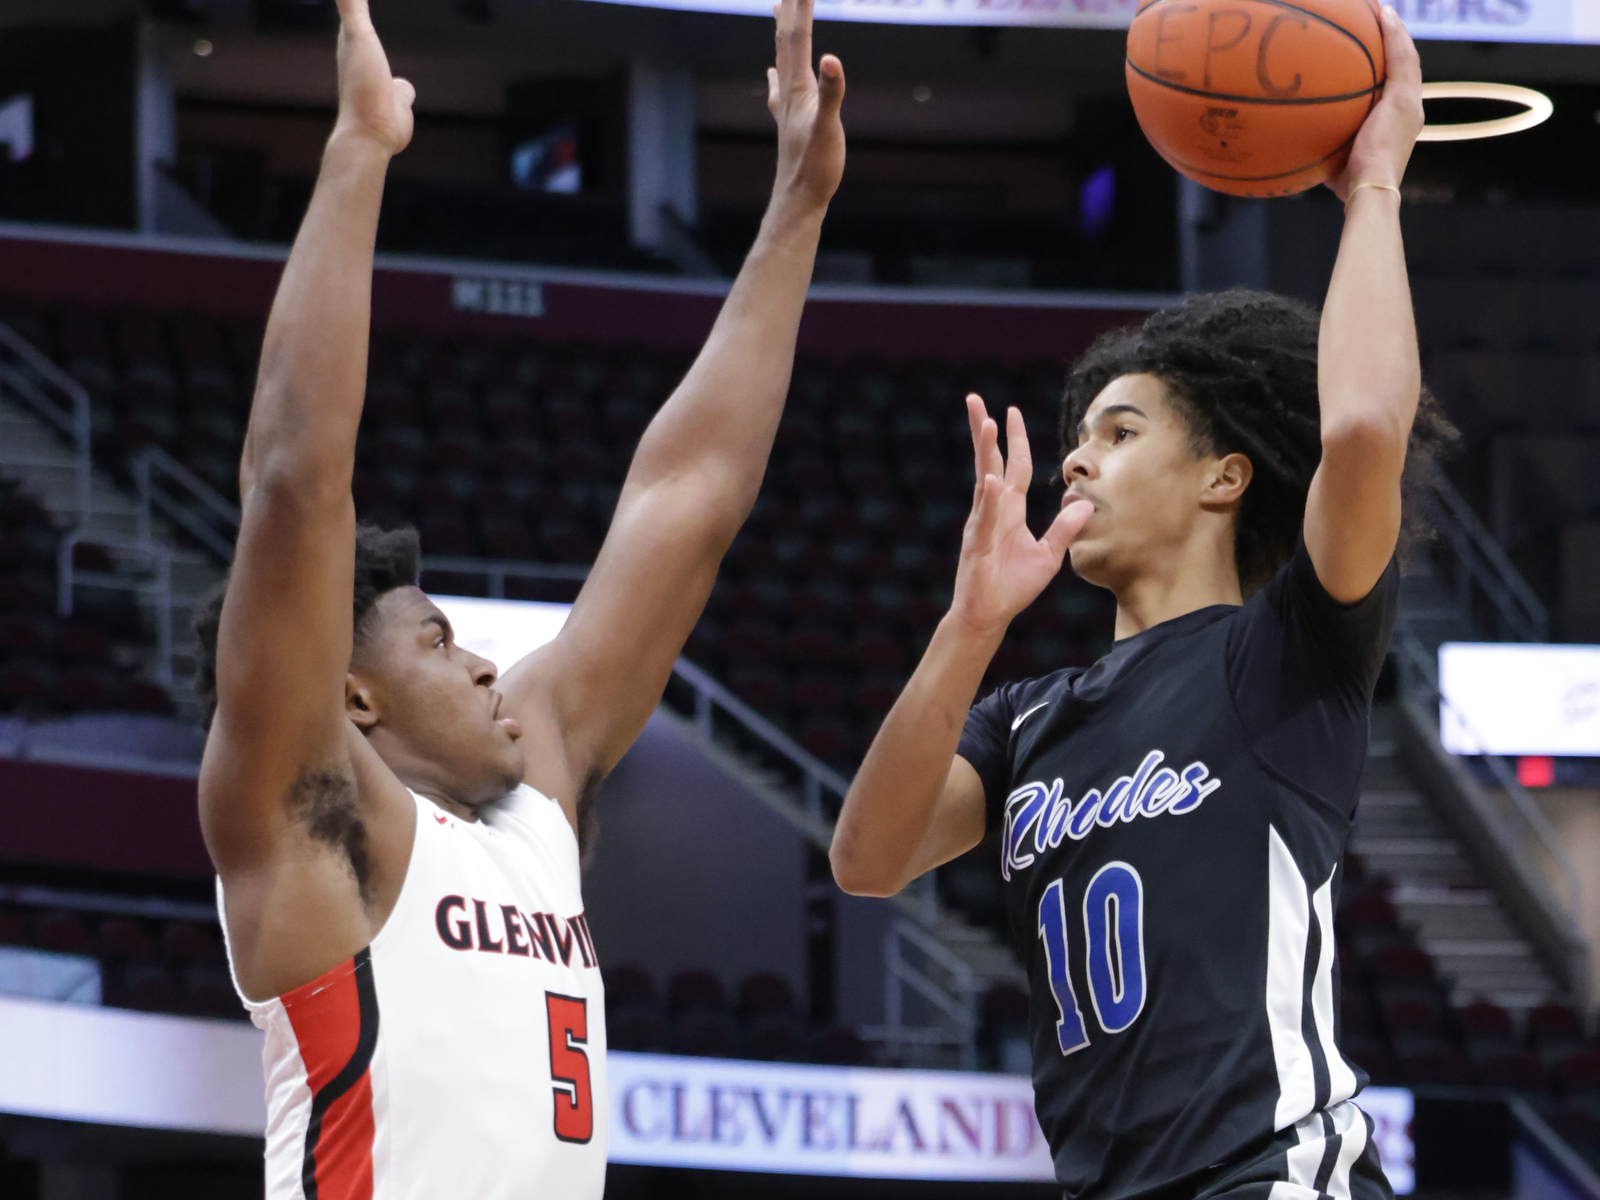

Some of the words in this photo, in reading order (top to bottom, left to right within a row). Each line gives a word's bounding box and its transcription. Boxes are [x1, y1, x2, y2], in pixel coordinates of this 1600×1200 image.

[1154, 5, 1308, 99] EPC
[1001, 749, 1221, 882] Rhodes
[1038, 861, 1147, 1056] 10
[544, 990, 594, 1145] 5
[620, 1078, 1036, 1157] CLEVELAND
